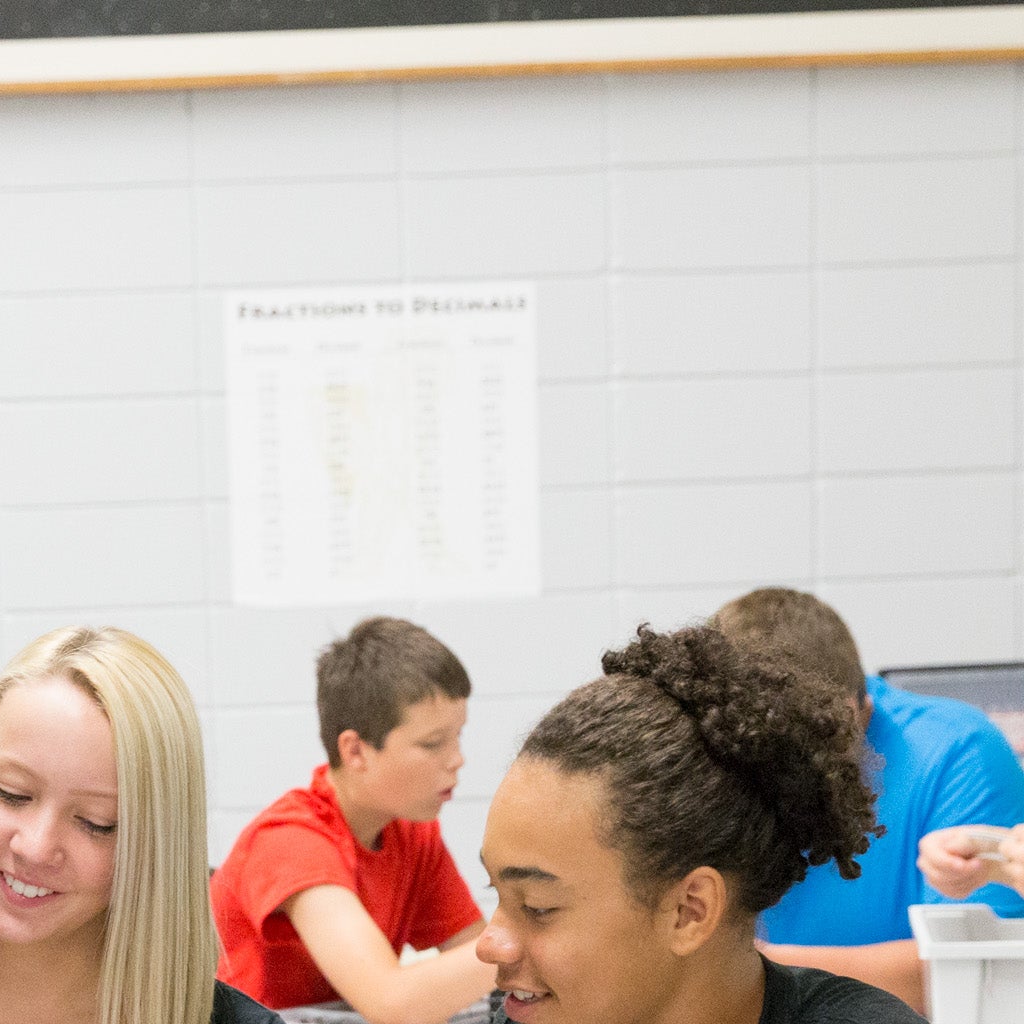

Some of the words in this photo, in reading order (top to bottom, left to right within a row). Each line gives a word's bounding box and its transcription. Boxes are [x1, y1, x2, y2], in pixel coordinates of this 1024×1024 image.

[237, 301, 367, 320] FRACTIONS
[375, 299, 404, 315] TO
[412, 295, 528, 314] DECIMALS
